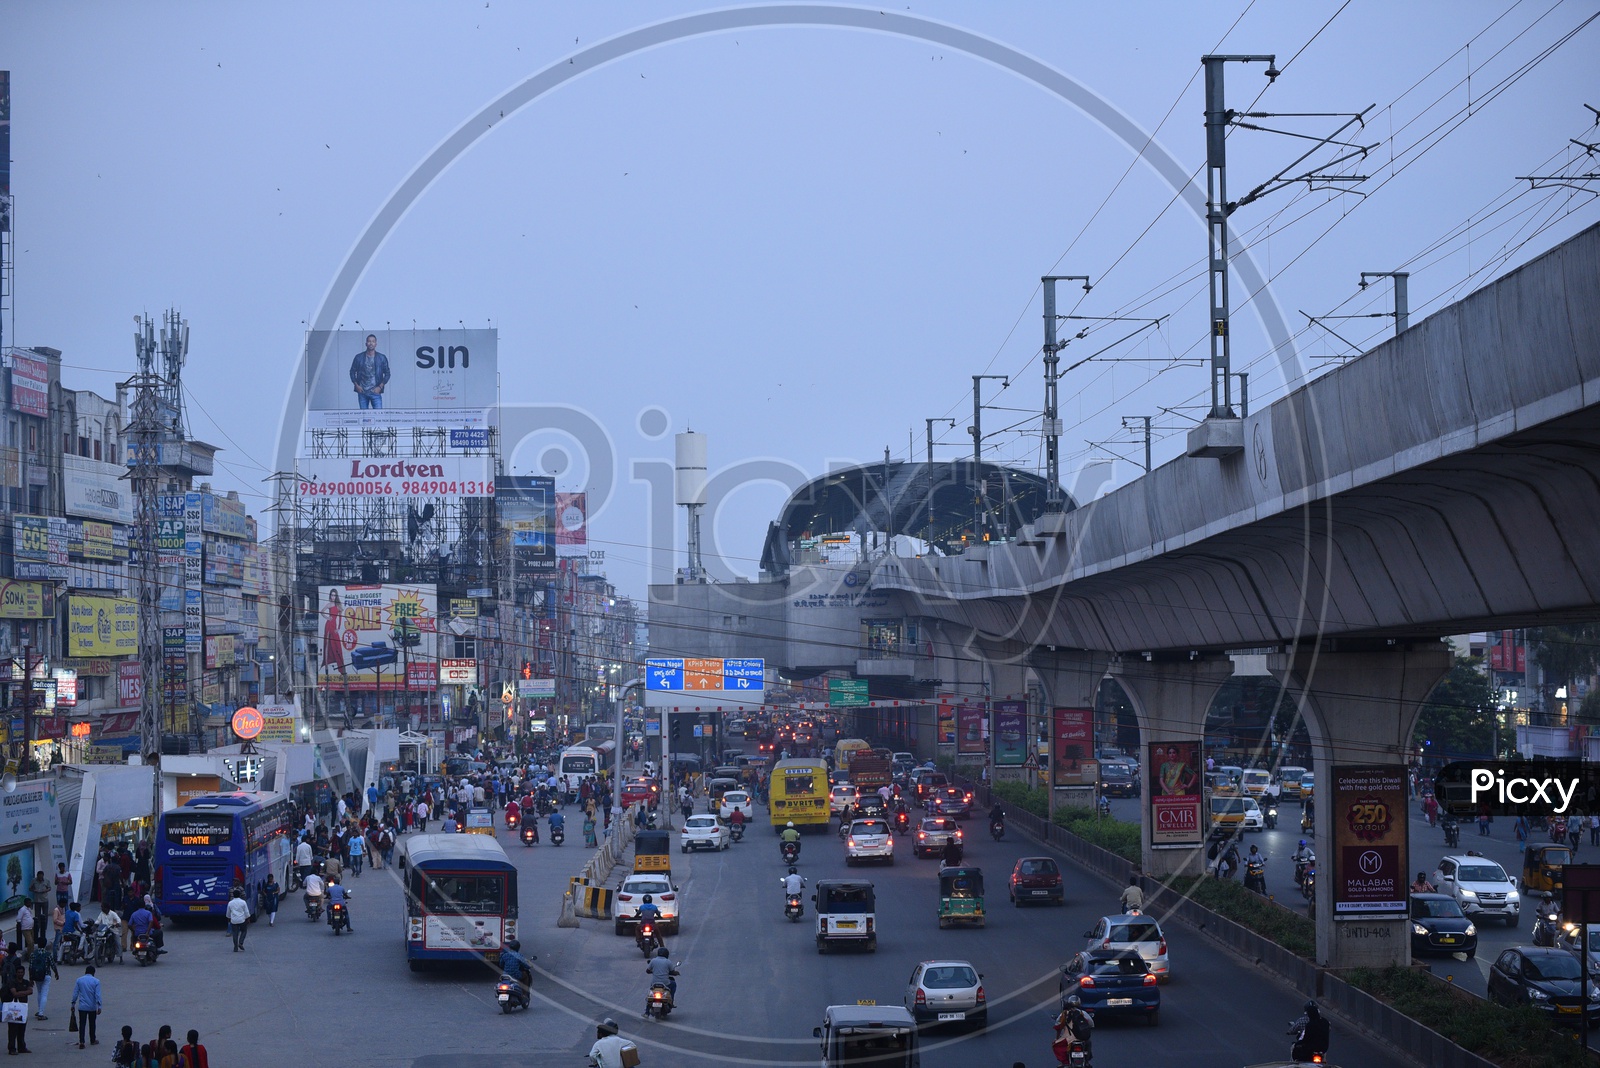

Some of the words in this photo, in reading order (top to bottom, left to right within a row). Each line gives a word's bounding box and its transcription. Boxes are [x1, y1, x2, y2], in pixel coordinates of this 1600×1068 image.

[351, 460, 444, 478] Lordven
[402, 480, 494, 494] 9849041316
[166, 497, 184, 510] SAP
[187, 510, 200, 520] SSC
[186, 525, 200, 534] BANK
[23, 526, 48, 550] CCE
[155, 538, 184, 549] ADOOP
[187, 558, 200, 568] SSC
[186, 573, 200, 581] BANK
[5, 591, 24, 606] SONA
[186, 607, 200, 616] SSC
[394, 602, 418, 616] FREE
[344, 606, 382, 630] SALE
[166, 628, 184, 637] SAP
[186, 622, 200, 630] BANK
[90, 660, 110, 674] MESS
[121, 678, 141, 698] MES
[234, 716, 260, 731] Chai
[1159, 810, 1194, 823] CMR
[1352, 804, 1386, 824] 250
[1348, 879, 1394, 887] MALABAR
